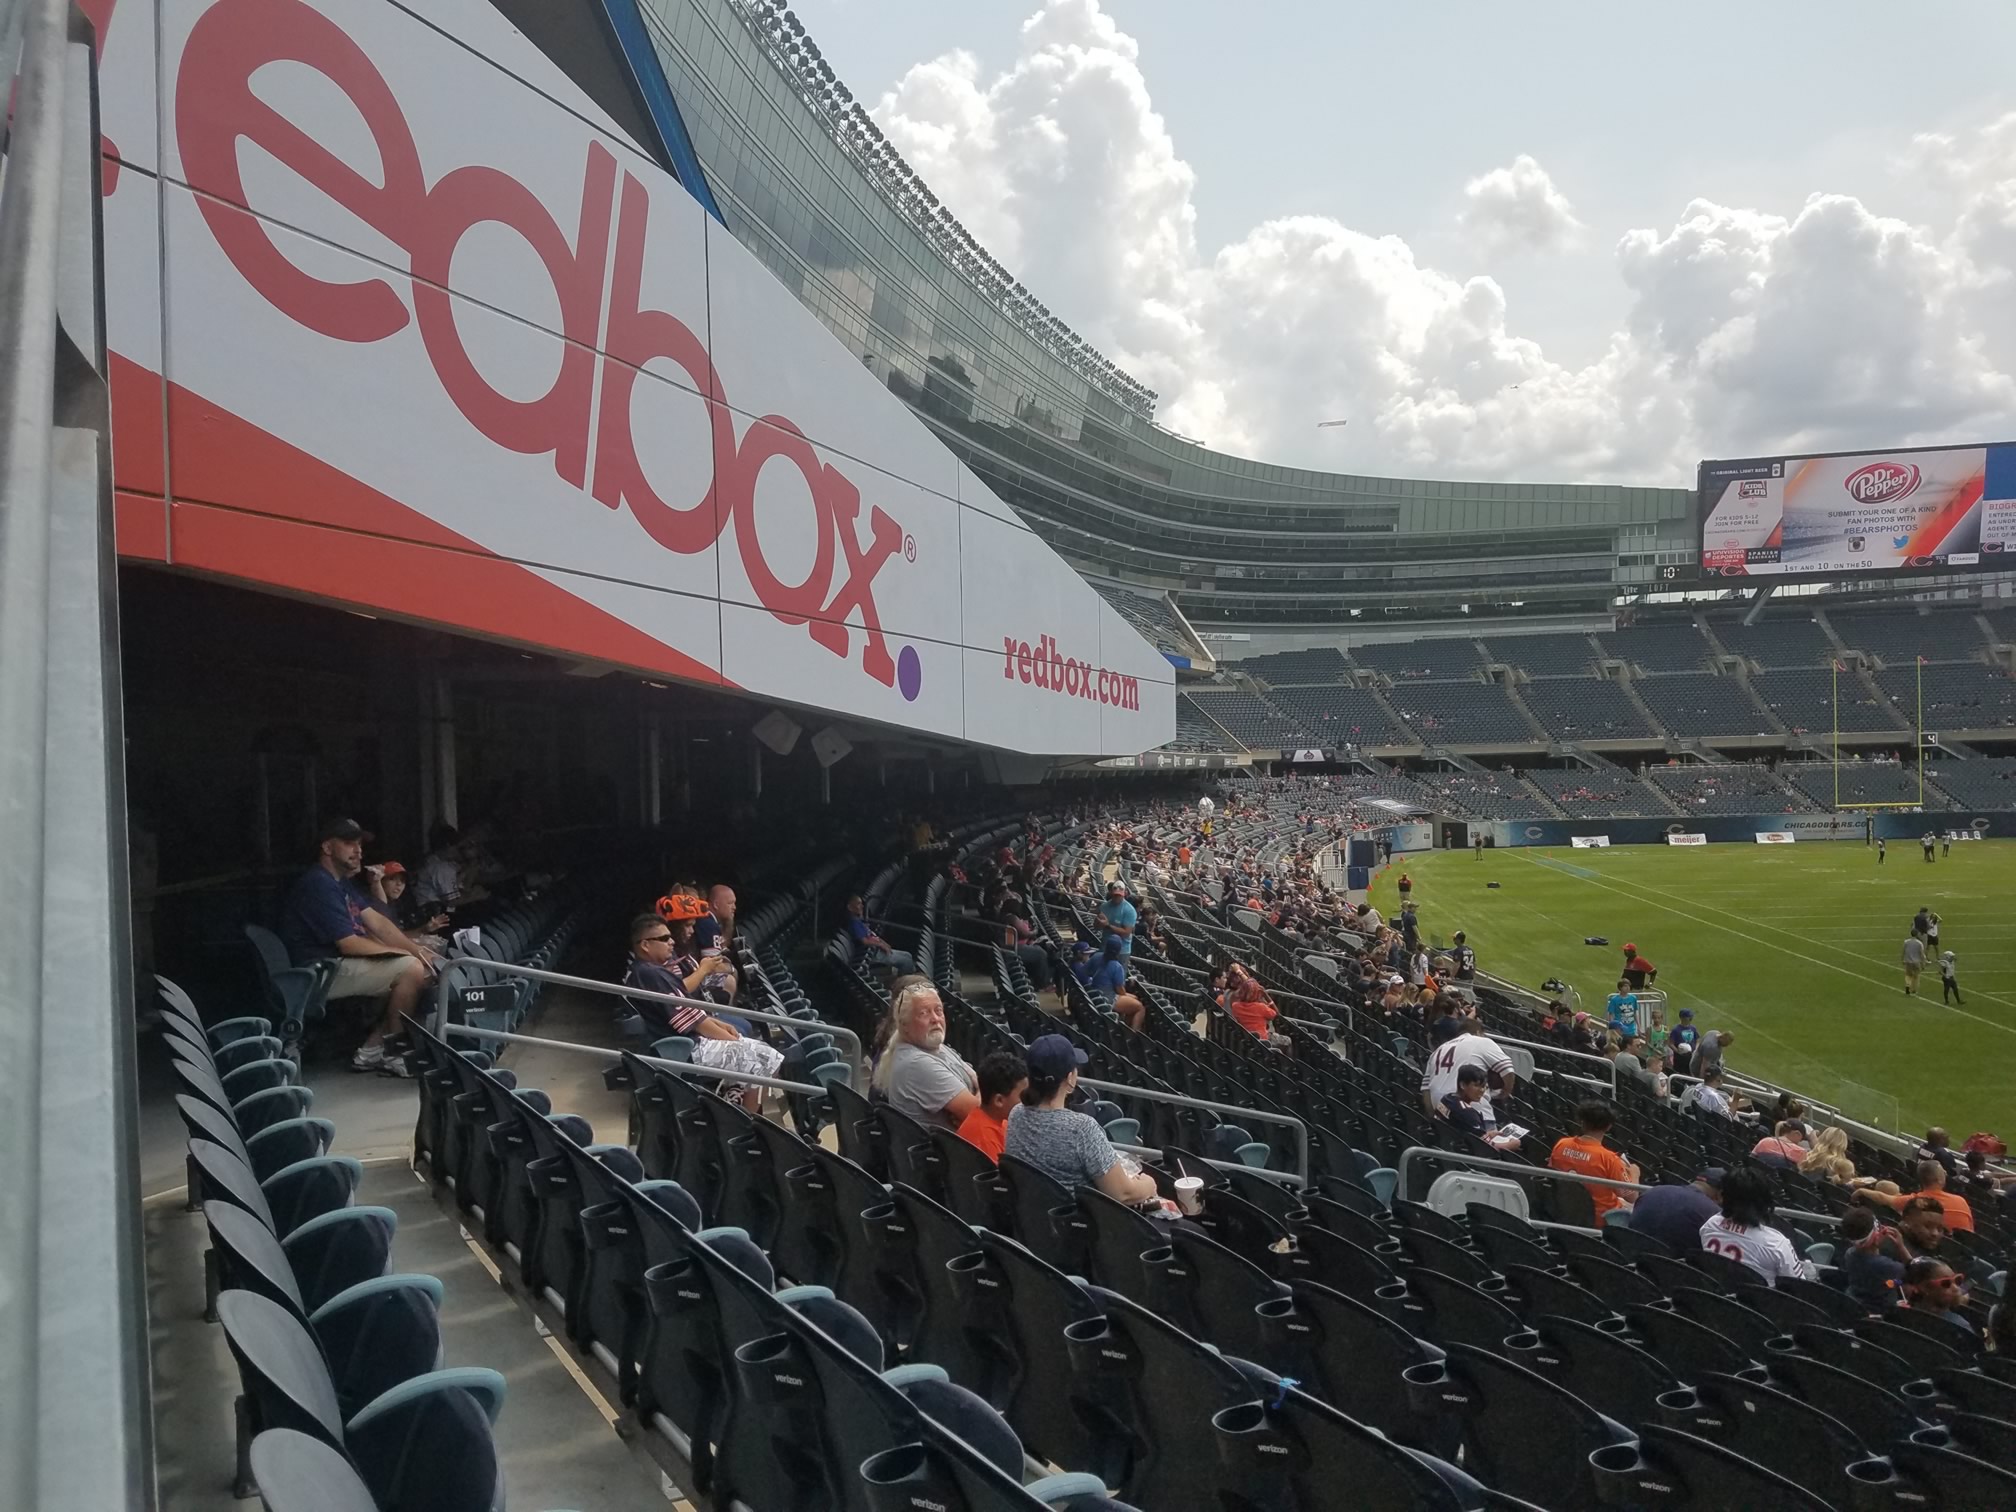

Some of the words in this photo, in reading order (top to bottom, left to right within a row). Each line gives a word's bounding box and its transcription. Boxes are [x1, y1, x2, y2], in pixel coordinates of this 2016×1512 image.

[76, 0, 903, 689] edbox
[1873, 468, 1895, 484] Dr
[1859, 472, 1907, 499] Pepper
[1827, 510, 1856, 518] SUBMIT
[1863, 516, 1895, 524] PHOTOS
[1843, 524, 1918, 535] #BEARSPHOTOS
[1818, 562, 1829, 570] 10
[1861, 560, 1873, 568] 50
[1003, 633, 1140, 712] redbox.com
[1673, 835, 1700, 844] meijer
[1462, 955, 1474, 970] 34
[465, 991, 485, 1001] 101
[1434, 1045, 1457, 1076] 14
[607, 1226, 628, 1234] verizon
[977, 1278, 999, 1287] verizon
[677, 1289, 701, 1299] verizon
[1287, 1324, 1309, 1333] verizon
[1101, 1348, 1127, 1360] verizon
[1536, 1356, 1560, 1365] verizon
[774, 1373, 803, 1386] verizon
[1441, 1394, 1468, 1403] verizon
[1696, 1417, 1722, 1426] verizon
[1257, 1443, 1289, 1455] verizon
[1639, 1481, 1671, 1493] verizon
[910, 1496, 946, 1512] verizon
